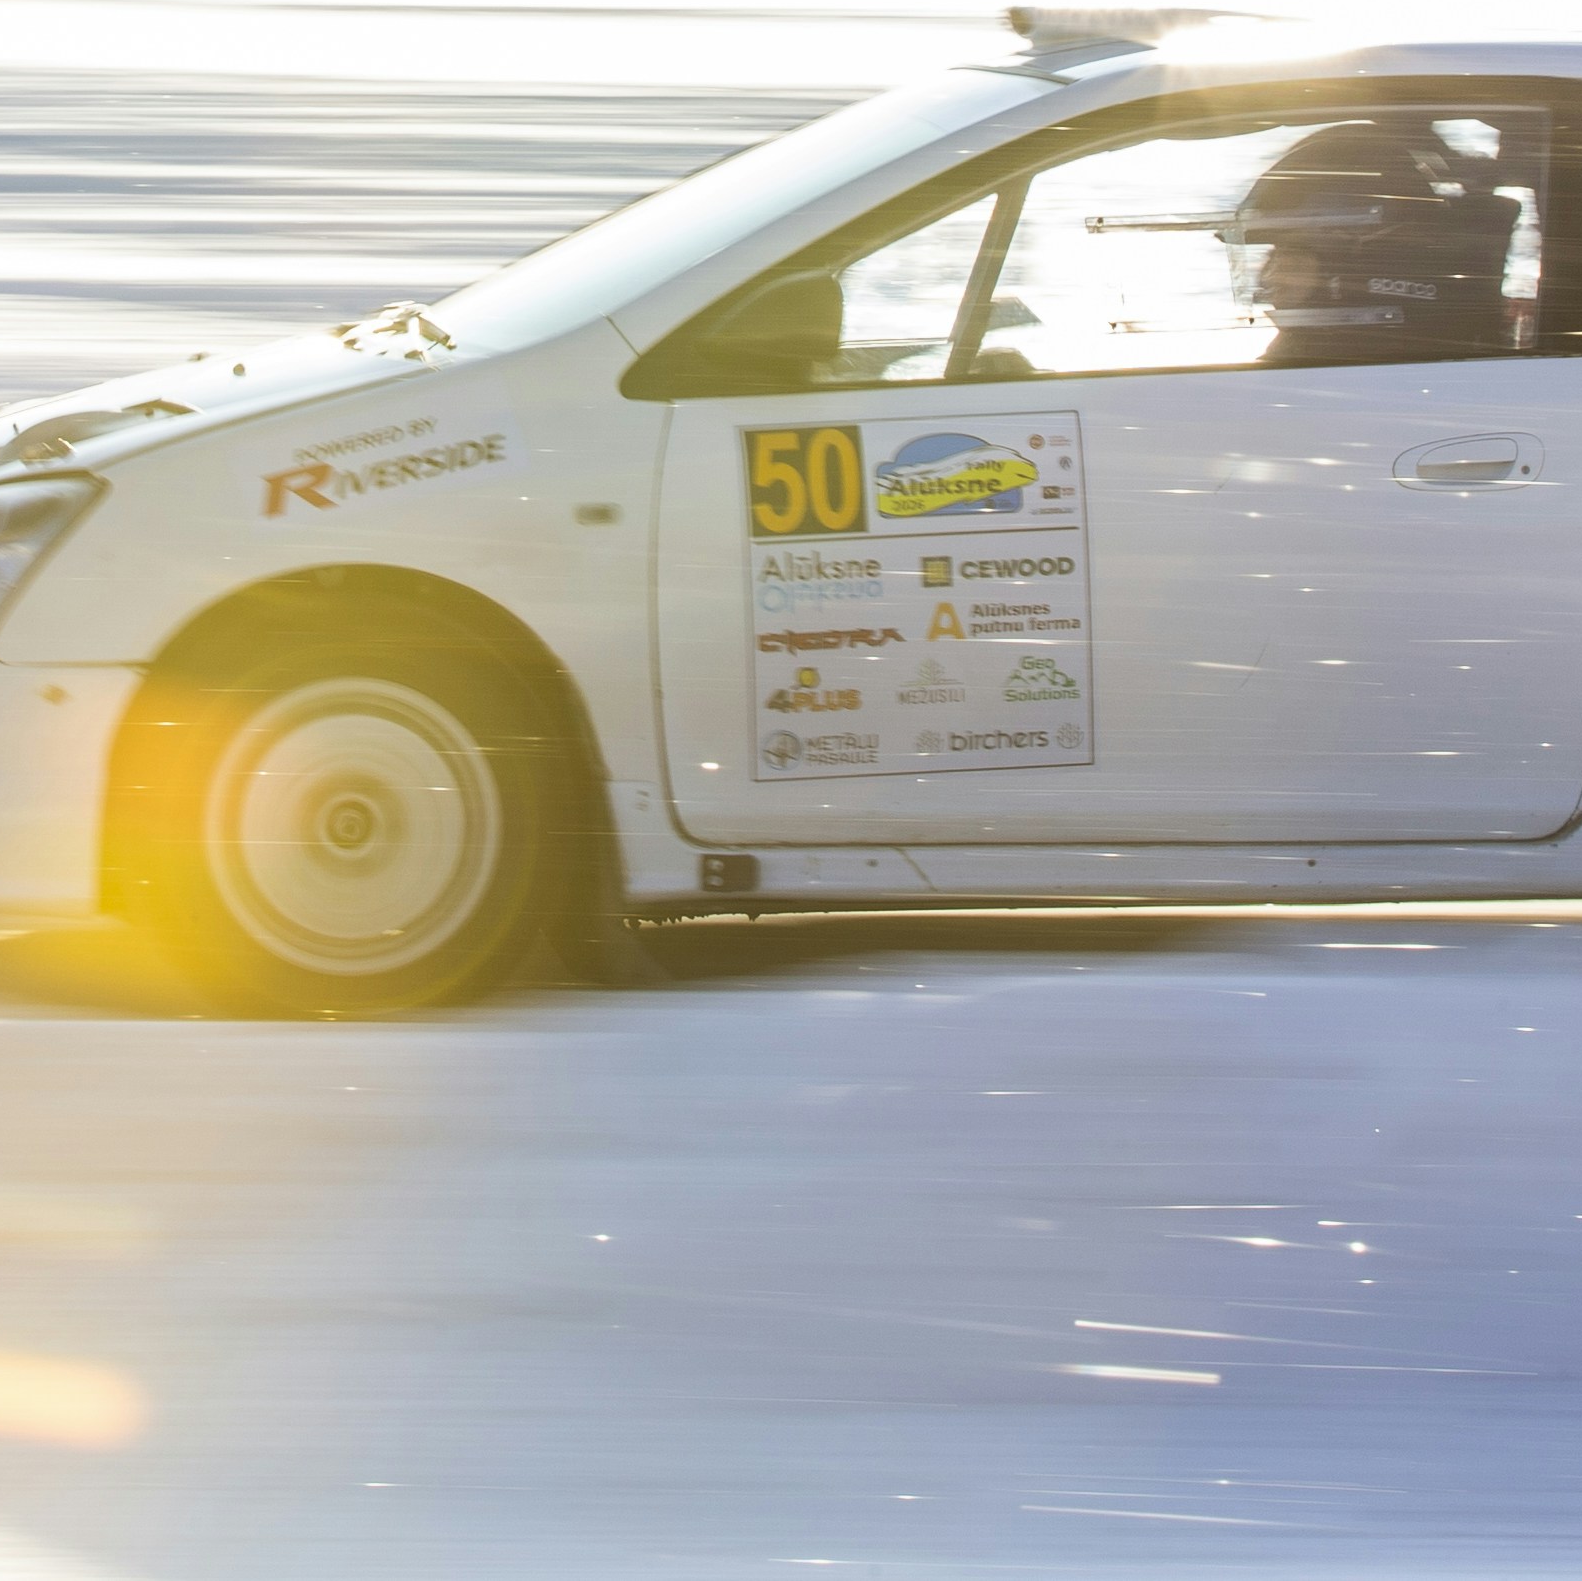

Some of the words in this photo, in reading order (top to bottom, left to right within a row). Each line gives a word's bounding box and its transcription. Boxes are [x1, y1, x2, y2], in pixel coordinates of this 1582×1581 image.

[293, 425, 404, 465] POWERED
[407, 416, 437, 437] BY
[261, 433, 507, 517] RIVERSIDE
[966, 459, 1007, 472] rally
[754, 427, 863, 534] 50
[889, 476, 1003, 497] Alūksne
[757, 550, 883, 583] Alūksne
[960, 556, 1076, 580] CEWOOD
[972, 603, 1051, 618] Alūksnes
[970, 620, 1024, 636] putnu
[1027, 617, 1081, 632] ferma
[1004, 688, 1081, 703] Solutions
[948, 729, 1049, 752] birchers
